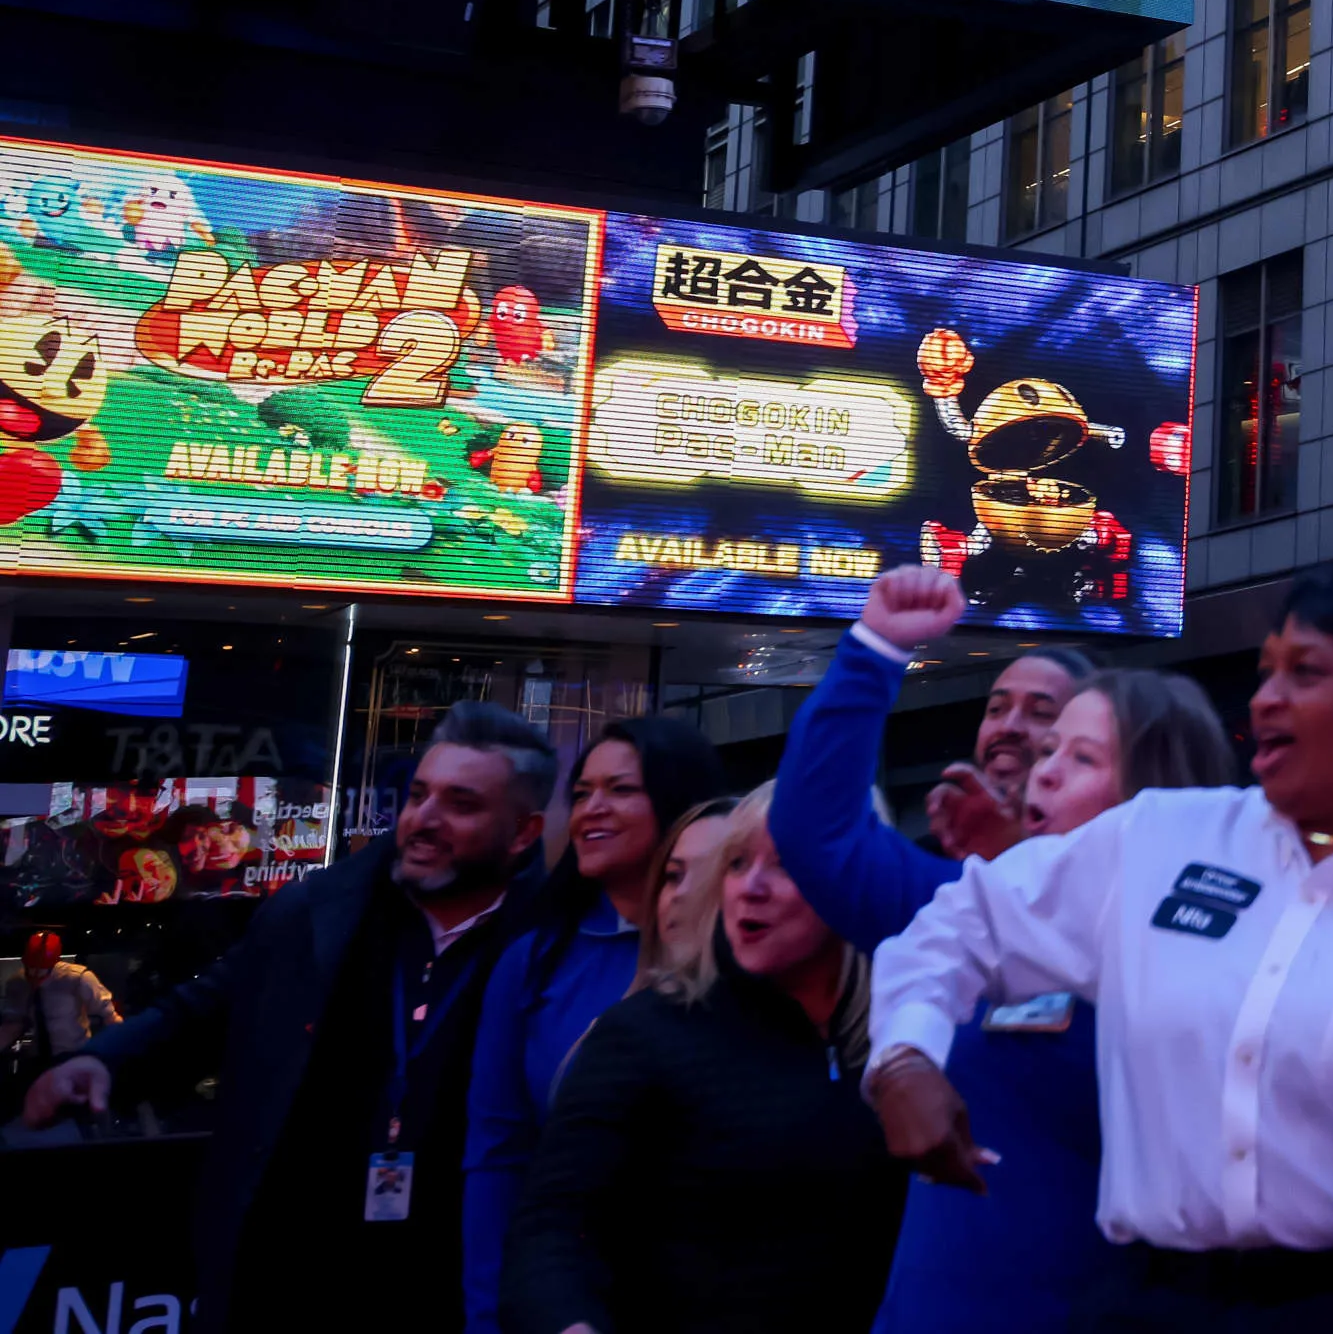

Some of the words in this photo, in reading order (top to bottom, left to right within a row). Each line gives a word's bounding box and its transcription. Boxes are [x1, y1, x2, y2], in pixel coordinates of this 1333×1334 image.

[661, 251, 836, 316] 超合金
[682, 311, 825, 340] CHOGOKIN
[177, 309, 380, 366] WORLD
[361, 308, 461, 408] 2
[655, 393, 850, 436] CHOGOKIN
[164, 441, 350, 492] AVAILABLE
[355, 456, 427, 495] NOW
[654, 423, 846, 470] Pac-Man
[615, 534, 800, 574] AVAILABLE
[809, 548, 882, 579] NOW
[53, 1279, 201, 1334] Na
